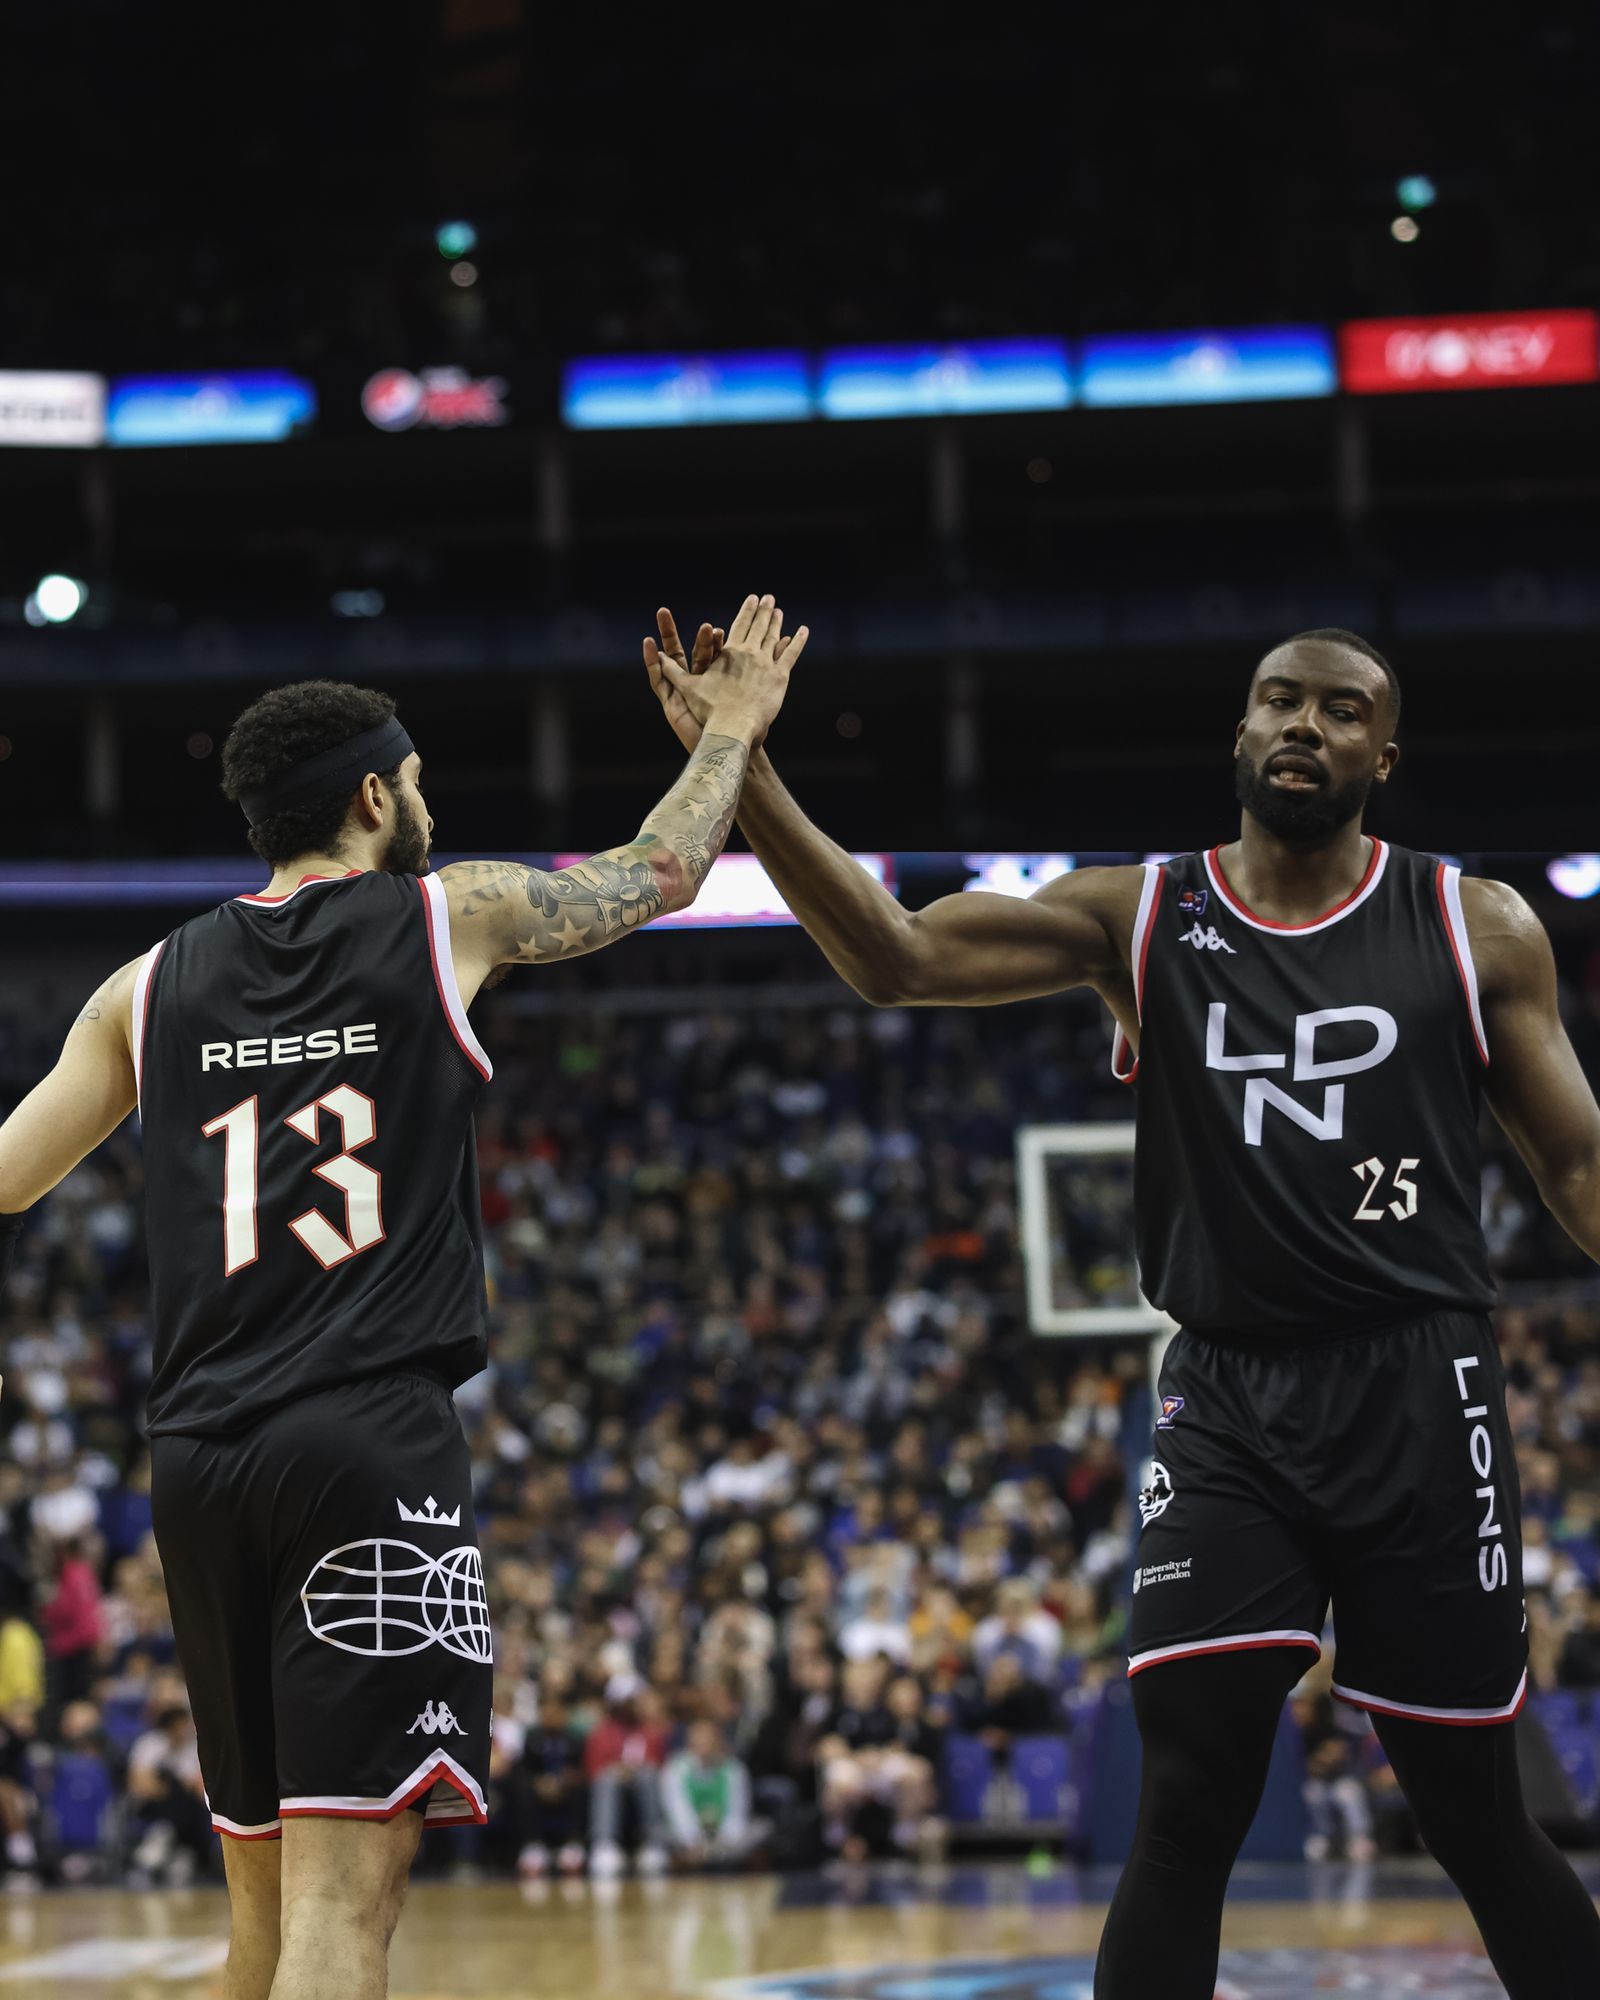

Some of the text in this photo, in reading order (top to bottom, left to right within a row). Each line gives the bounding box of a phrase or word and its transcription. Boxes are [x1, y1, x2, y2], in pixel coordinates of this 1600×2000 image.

[202, 1023, 379, 1072] REESE
[201, 1083, 387, 1277] 13
[1351, 1156, 1421, 1222] 25
[1453, 1356, 1508, 1592] LIONS
[1142, 1557, 1193, 1576] University of
[1142, 1569, 1191, 1586] East London
